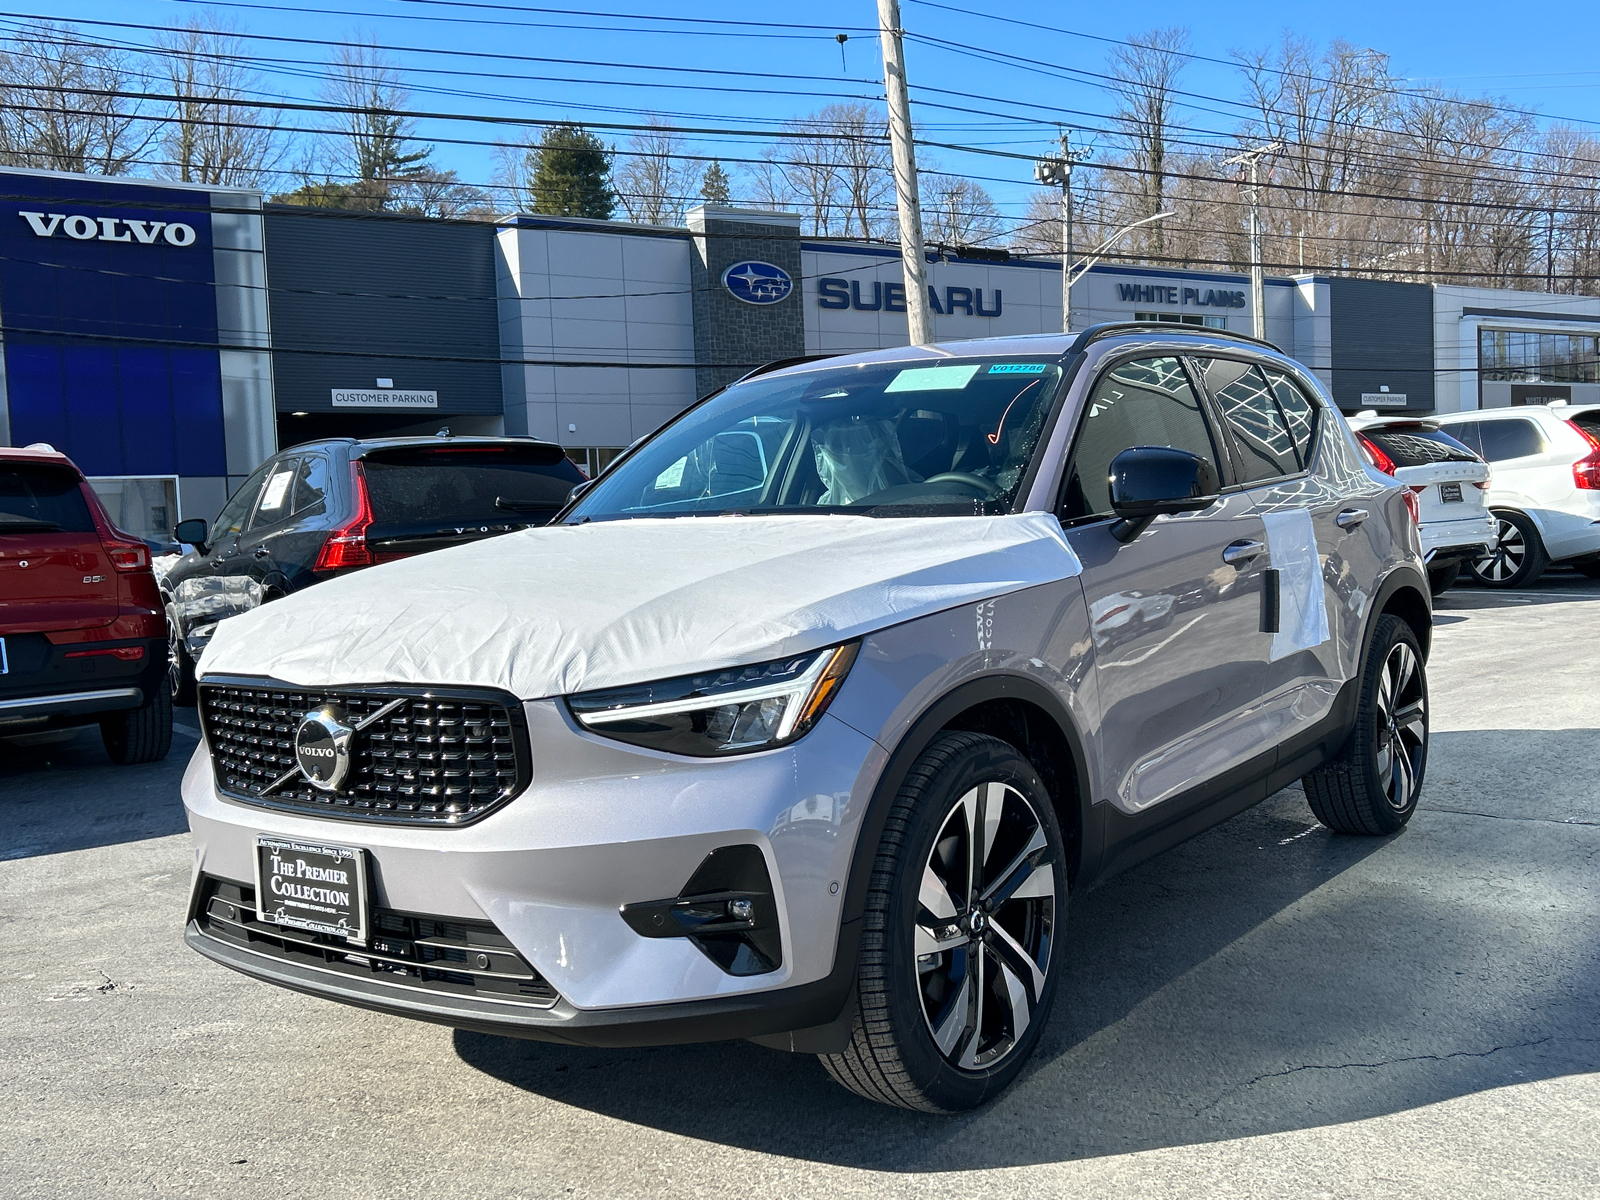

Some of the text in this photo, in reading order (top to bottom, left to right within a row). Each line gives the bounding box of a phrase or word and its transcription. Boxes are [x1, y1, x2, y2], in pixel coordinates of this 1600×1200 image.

[19, 211, 196, 247] VOLVO
[1118, 283, 1246, 308] WHITE PLAINS
[335, 393, 434, 403] CUSTOMER PARKING
[299, 746, 335, 757] VOLVO
[339, 849, 353, 858] 1995
[270, 855, 348, 885] THE PREMIER
[270, 876, 350, 906] COLLECTION
